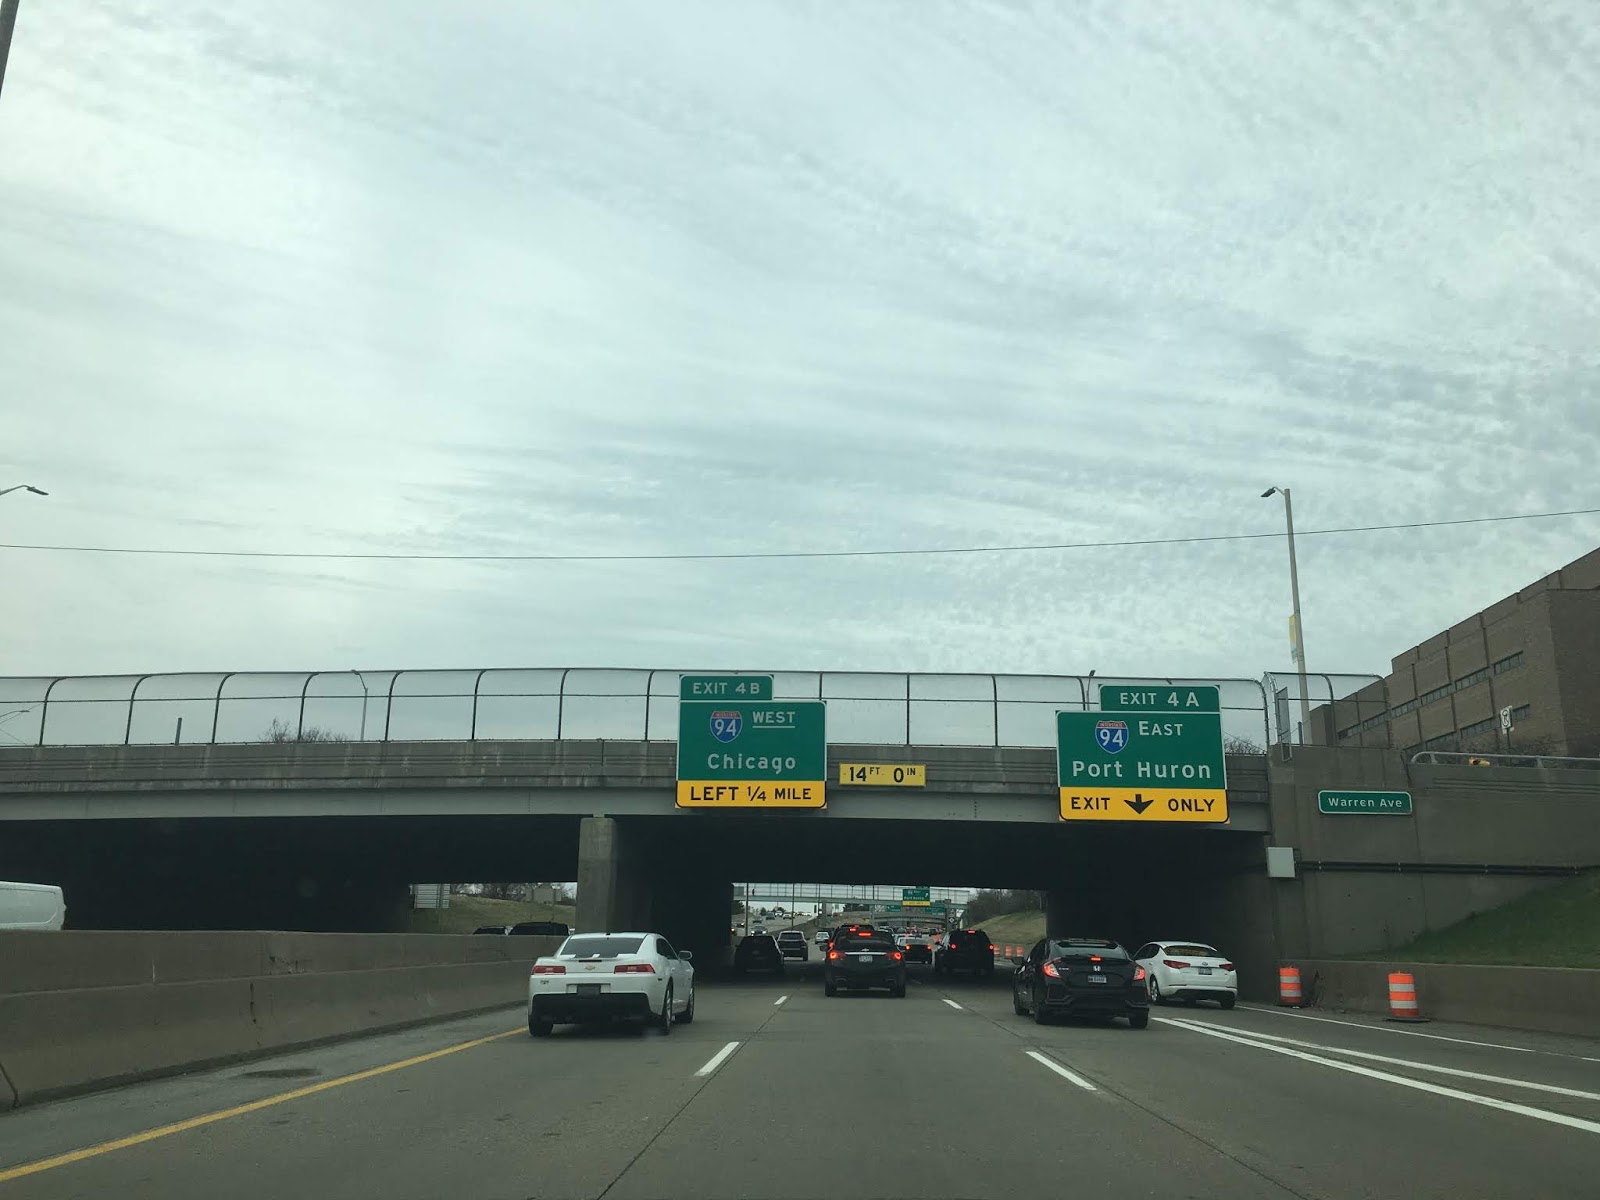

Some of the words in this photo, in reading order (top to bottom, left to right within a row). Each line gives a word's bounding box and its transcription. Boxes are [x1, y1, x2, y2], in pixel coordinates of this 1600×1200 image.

[692, 682, 728, 695] EXIT
[1119, 692, 1157, 705] EXIT
[714, 719, 737, 737] 94
[752, 711, 796, 724] WEST
[1099, 728, 1124, 747] 94
[1138, 720, 1183, 736] EAST
[707, 753, 796, 775] Chicago
[1072, 760, 1123, 778] Port
[1137, 761, 1211, 779] Huron
[690, 786, 739, 801] LEFT
[774, 787, 812, 800] MILE
[1071, 796, 1110, 810] EXIT
[1167, 798, 1215, 812] ONLY
[1328, 797, 1375, 807] Warren
[1379, 798, 1402, 808] Ave
